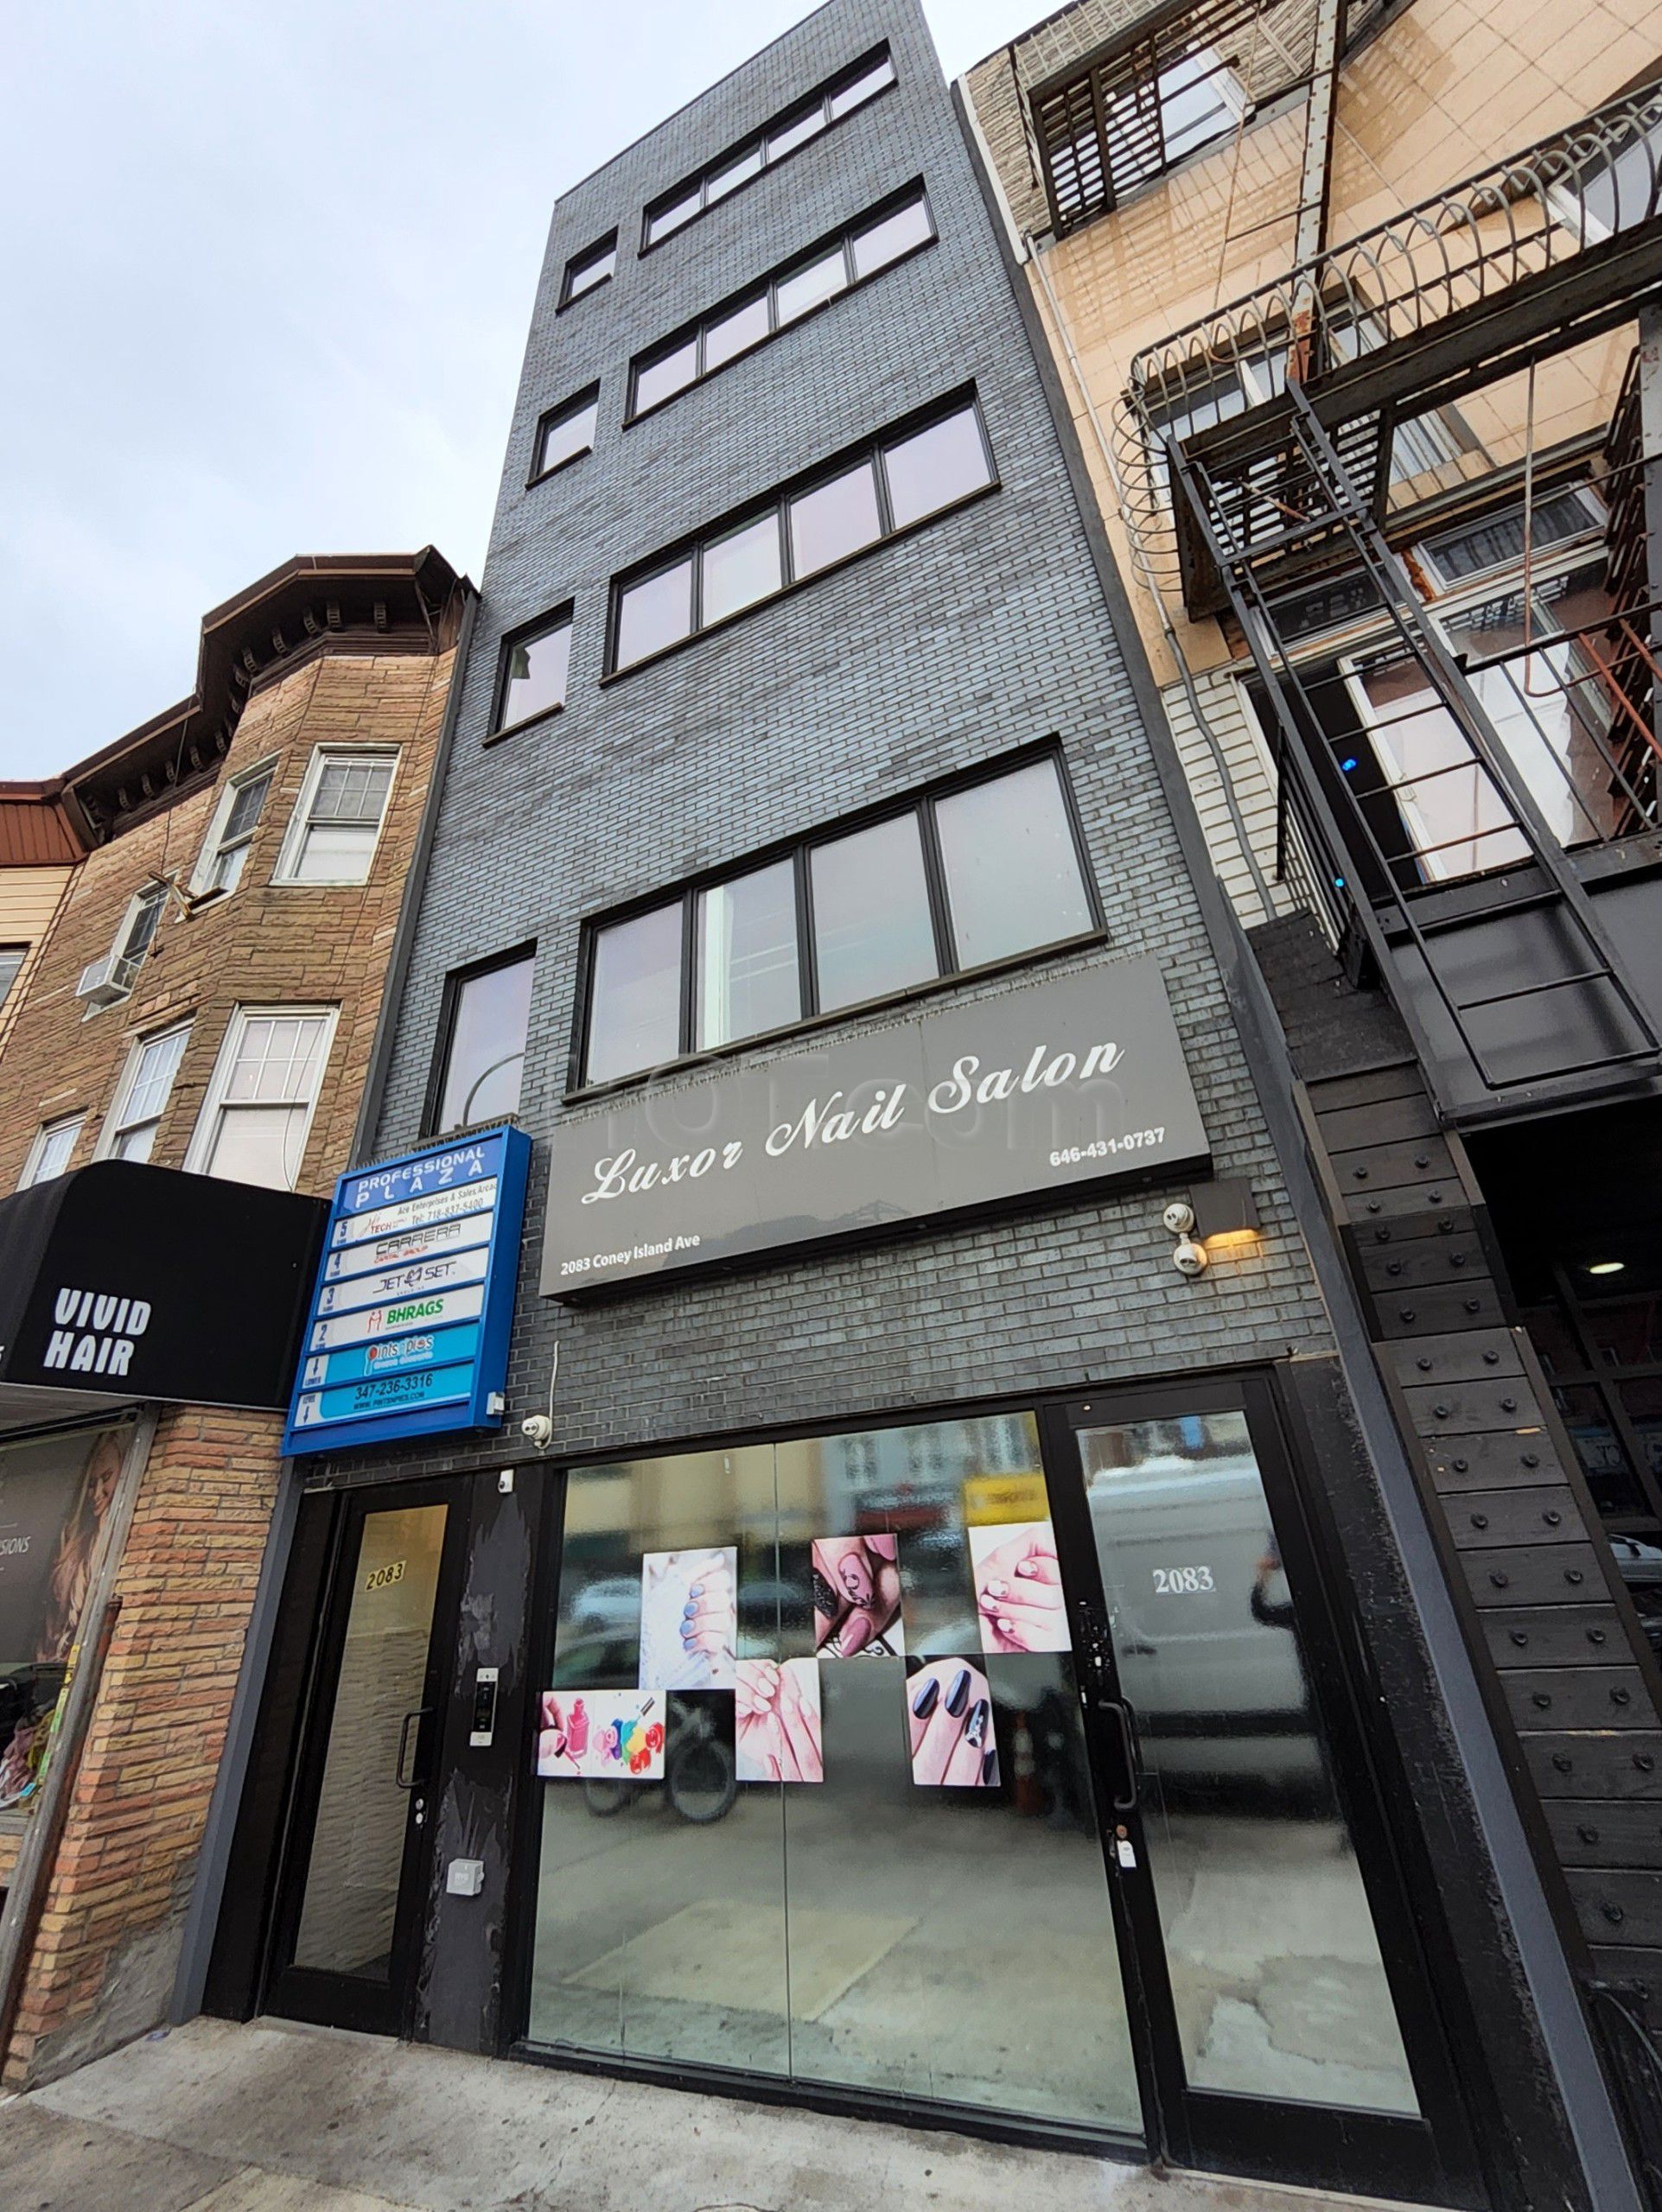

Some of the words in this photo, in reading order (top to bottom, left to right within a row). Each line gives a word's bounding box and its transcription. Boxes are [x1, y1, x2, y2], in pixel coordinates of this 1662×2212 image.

[581, 1141, 743, 1205] Luxor
[765, 1084, 907, 1157] Nail
[927, 1041, 1125, 1115] Salon
[1049, 1126, 1165, 1167] 646-431-0737
[358, 1146, 485, 1192] PROFESSIONAL
[341, 1221, 348, 1236] 5
[371, 1222, 392, 1234] TECH
[334, 1253, 341, 1269] 4
[560, 1257, 591, 1275] 2083
[592, 1250, 632, 1265] Coney
[634, 1237, 672, 1259] Island
[674, 1235, 701, 1250] Ave
[327, 1287, 335, 1305] 3
[373, 1274, 405, 1294] JET
[54, 1287, 151, 1336] VIVID
[386, 1299, 444, 1325] BHRAGS
[318, 1324, 328, 1342] 2
[43, 1331, 135, 1376] HAIR
[355, 1373, 433, 1400] 347-236-3316
[366, 1563, 403, 1590] 2083
[1153, 1566, 1213, 1593] 2083
